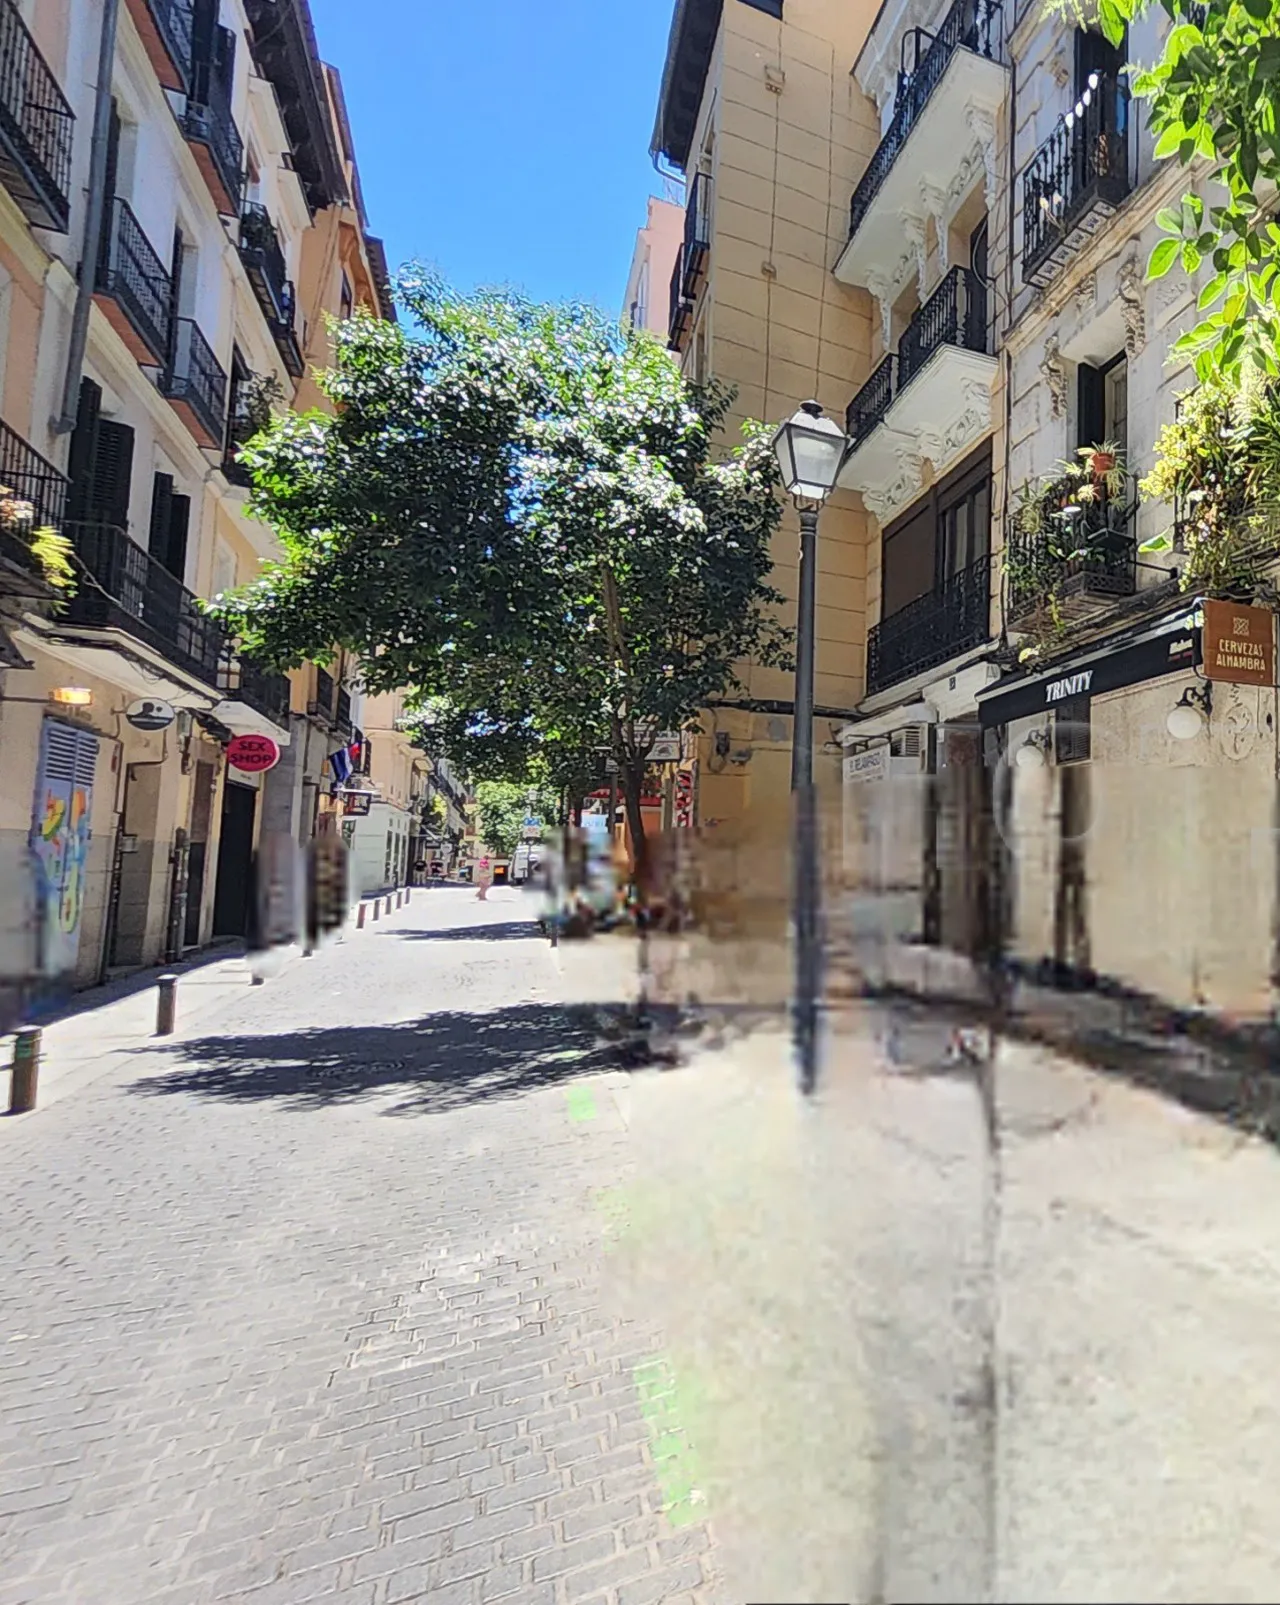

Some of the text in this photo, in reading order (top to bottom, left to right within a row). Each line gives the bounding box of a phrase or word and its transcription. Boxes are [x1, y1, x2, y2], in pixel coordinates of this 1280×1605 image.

[1218, 639, 1264, 657] CERVEZAS
[1216, 653, 1266, 672] ALHAMBRA
[1045, 669, 1093, 703] TRINITY
[238, 741, 266, 751] SEX
[230, 753, 273, 763] SHOP
